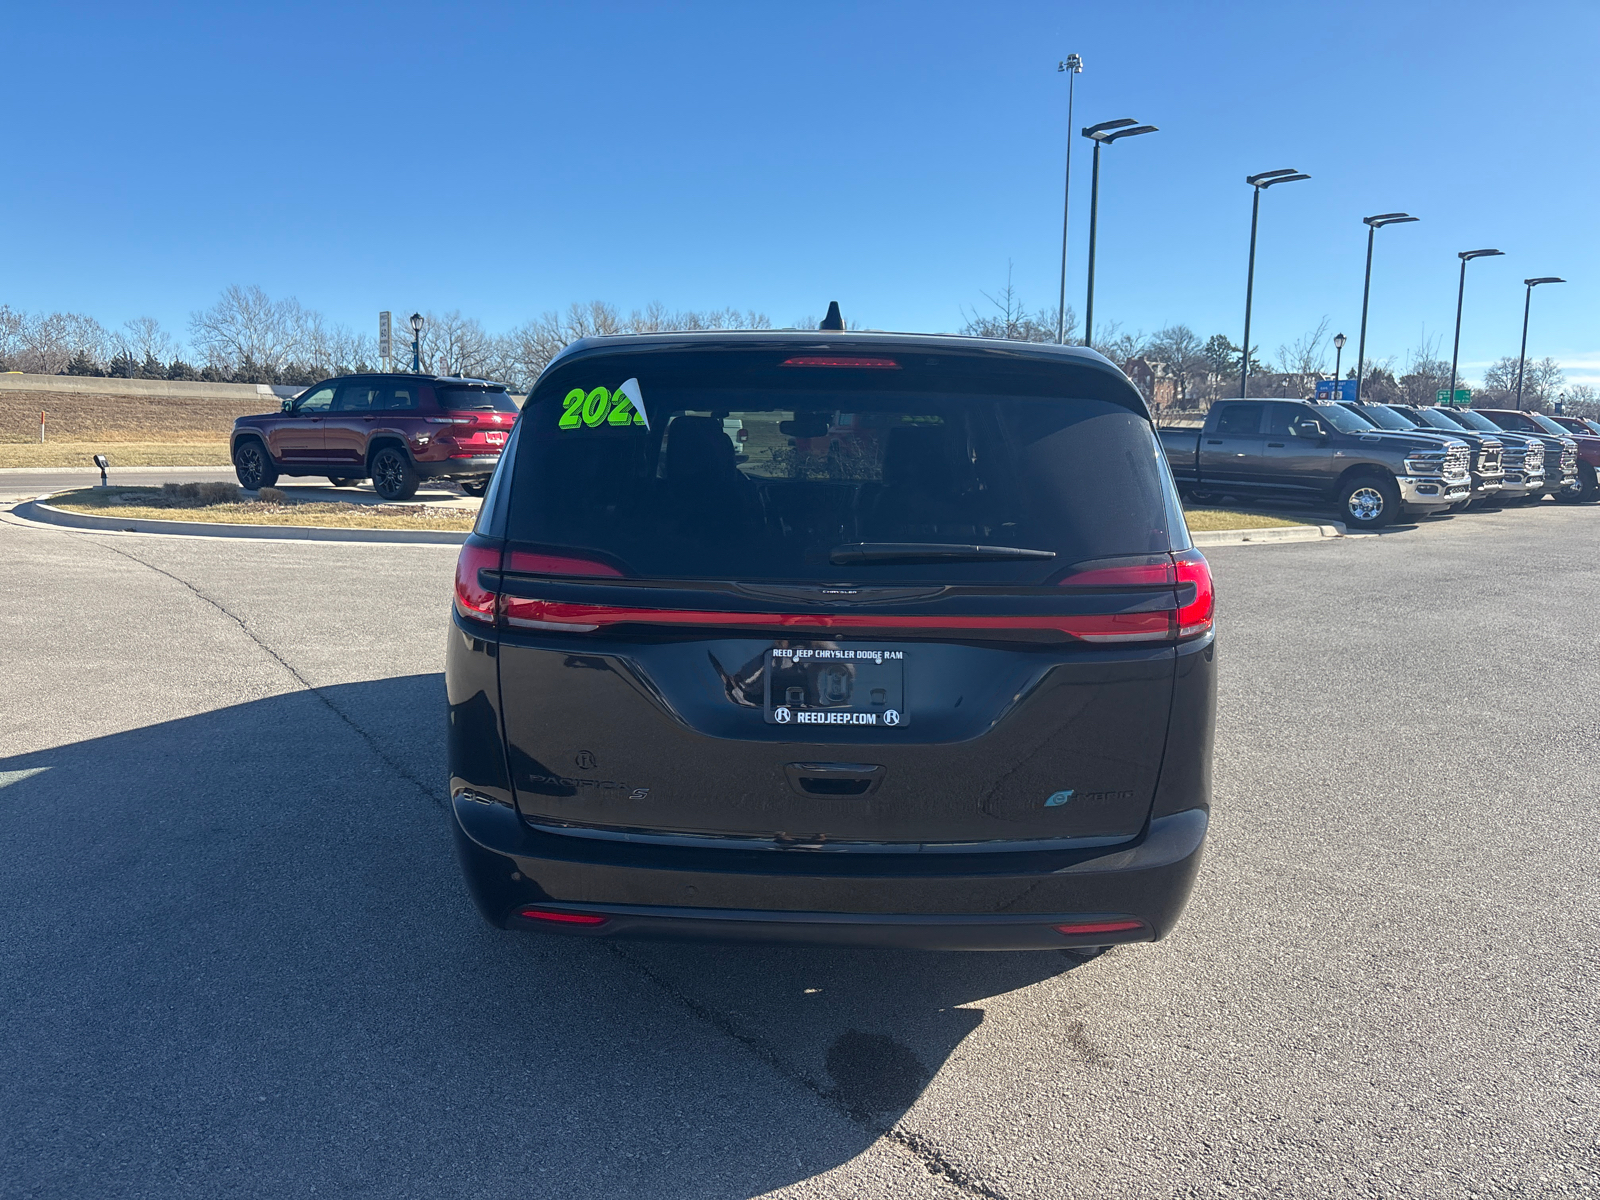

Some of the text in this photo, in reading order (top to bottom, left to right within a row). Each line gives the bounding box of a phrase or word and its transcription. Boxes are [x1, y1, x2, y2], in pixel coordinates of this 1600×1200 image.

[773, 649, 903, 660] REED JEEP CHRYSLER DODGE RAM
[797, 712, 877, 725] REEDJEEP.COM
[529, 774, 632, 791] PACIFICA
